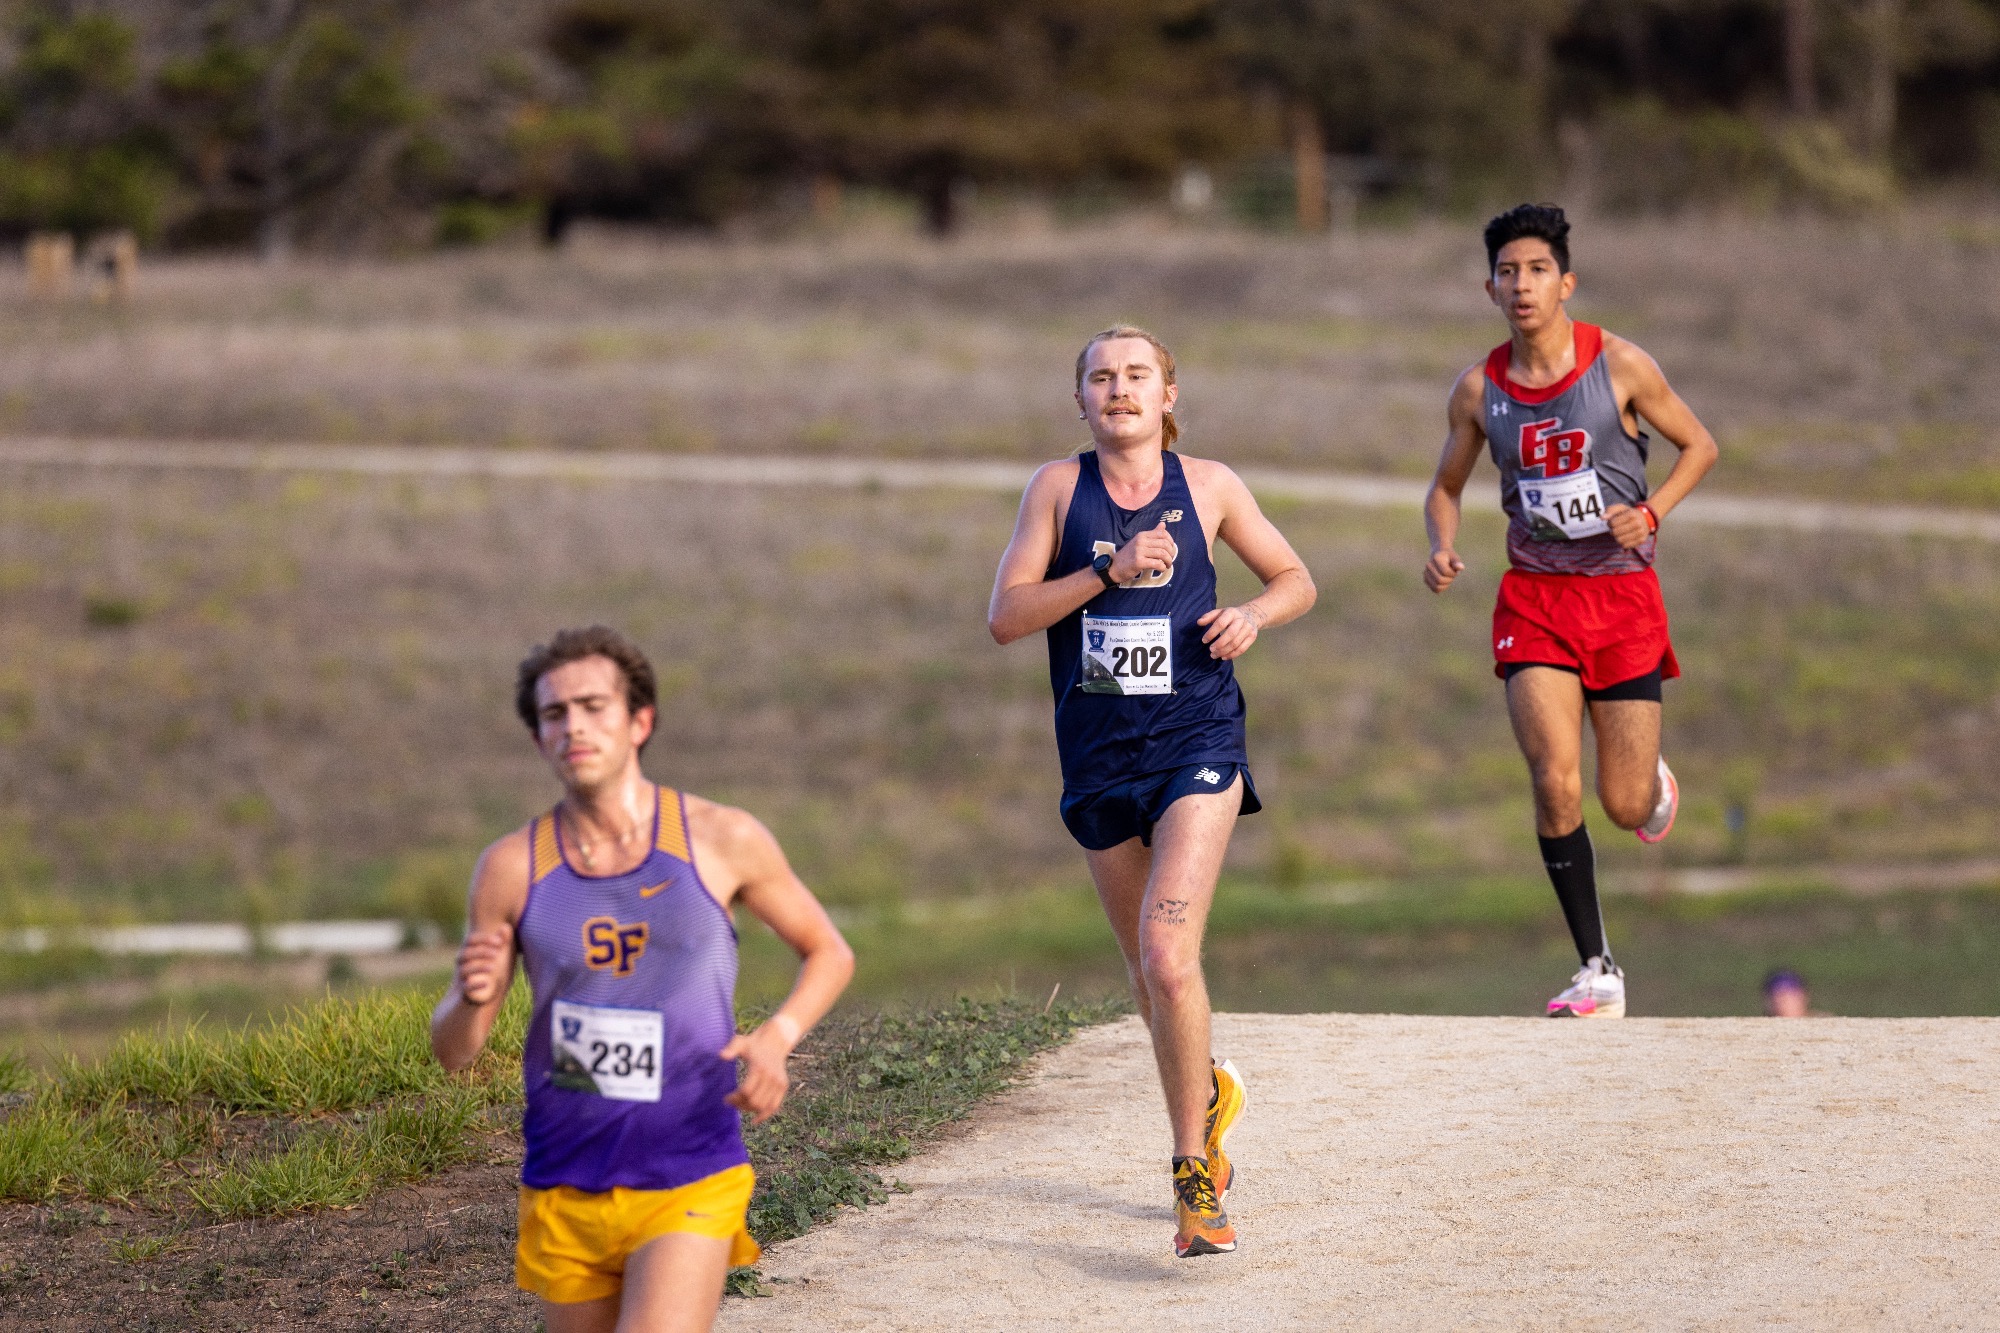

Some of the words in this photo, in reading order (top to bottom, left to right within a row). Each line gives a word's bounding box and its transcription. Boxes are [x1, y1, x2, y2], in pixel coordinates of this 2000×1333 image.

[1519, 416, 1592, 478] EB
[1552, 494, 1602, 525] 144
[1112, 646, 1167, 678] 202
[582, 915, 650, 979] SF
[591, 1040, 655, 1078] 234
